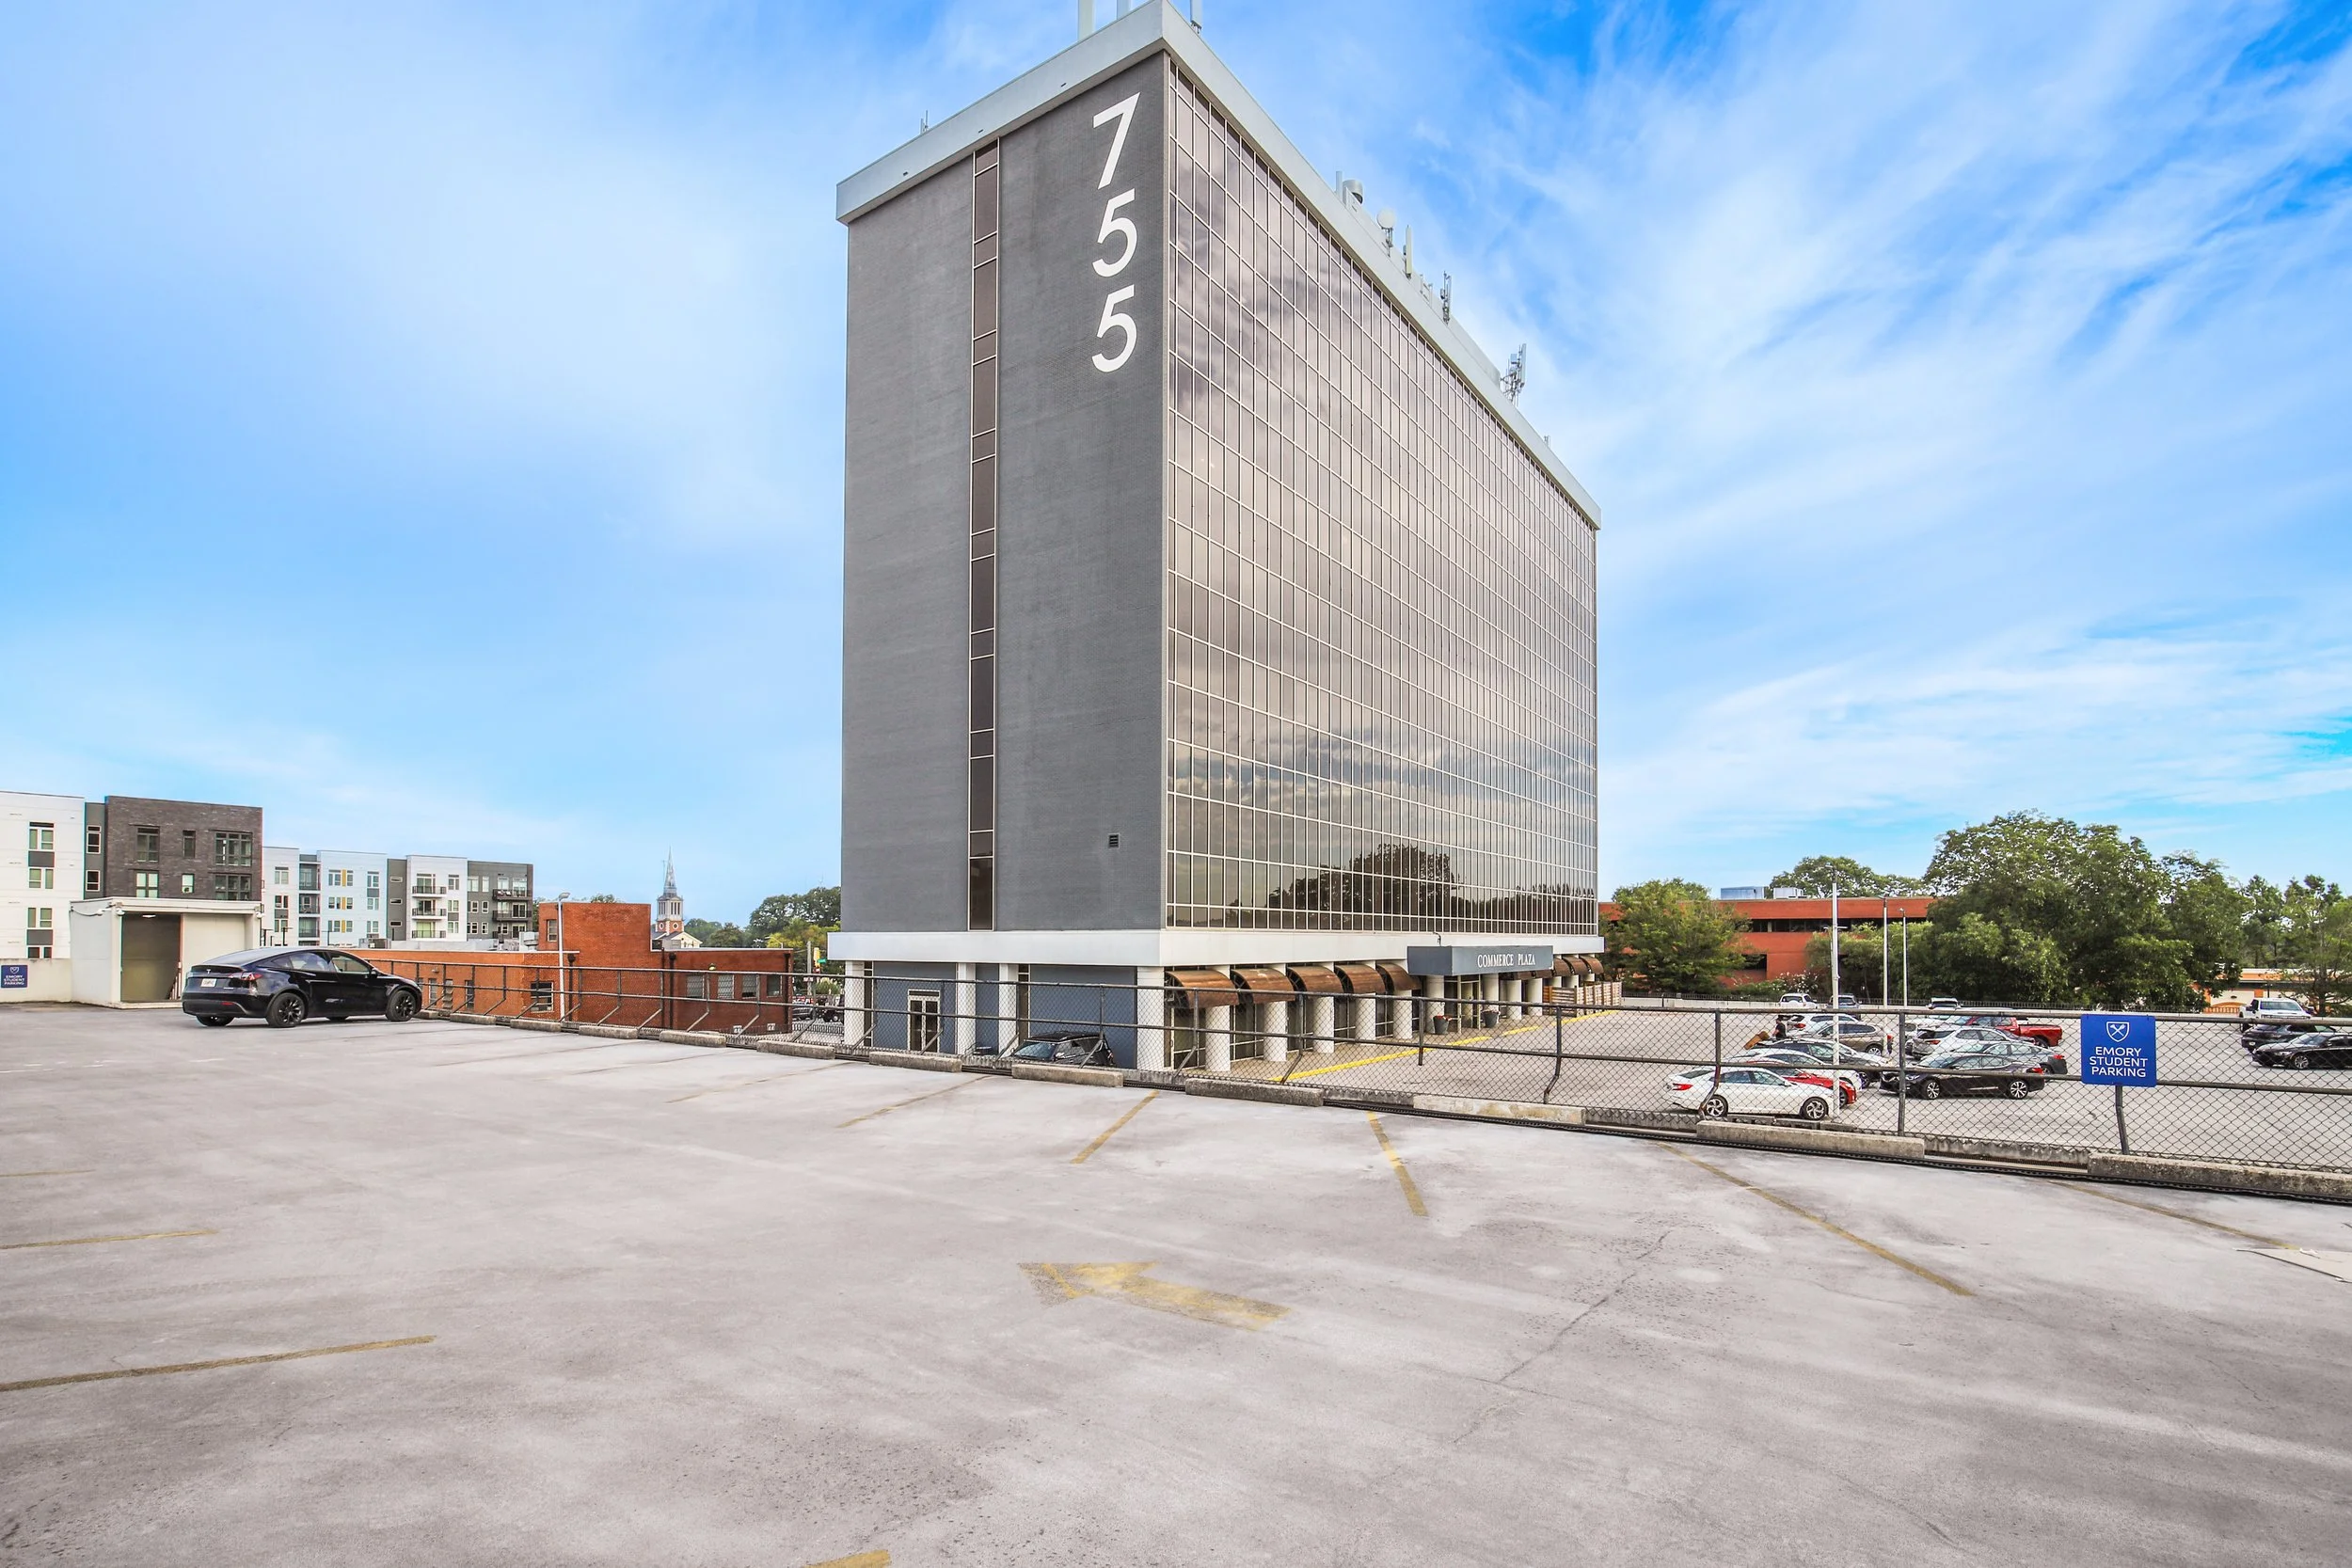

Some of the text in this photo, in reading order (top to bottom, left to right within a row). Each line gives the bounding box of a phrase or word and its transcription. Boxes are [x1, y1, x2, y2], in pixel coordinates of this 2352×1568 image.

[1092, 91, 1141, 373] 755
[1477, 953, 1535, 968] COMMERCE PLAZA
[2095, 1046, 2142, 1057] EMORY
[2089, 1056, 2149, 1068] STUDENT
[2091, 1067, 2146, 1078] PARKING
